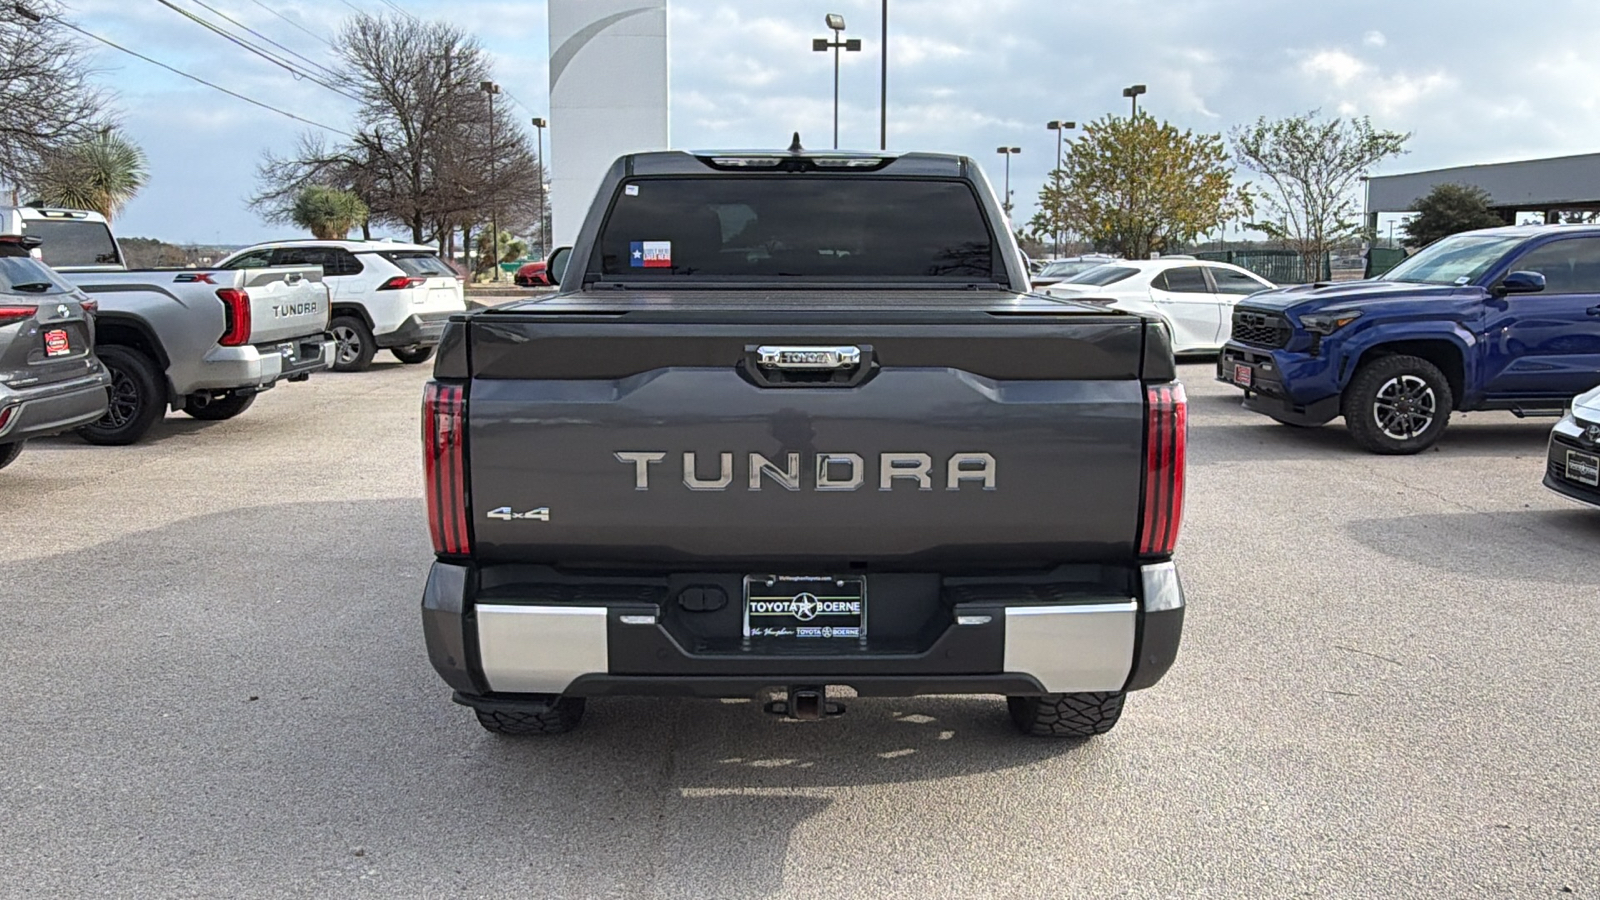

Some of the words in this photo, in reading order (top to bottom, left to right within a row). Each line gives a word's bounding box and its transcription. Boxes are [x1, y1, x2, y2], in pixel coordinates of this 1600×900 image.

[272, 302, 317, 318] TUNDRA
[784, 352, 831, 363] TOYOTA
[614, 451, 997, 492] TUNDRA
[750, 601, 798, 612] TOYOTA
[816, 601, 861, 612] BOERNE
